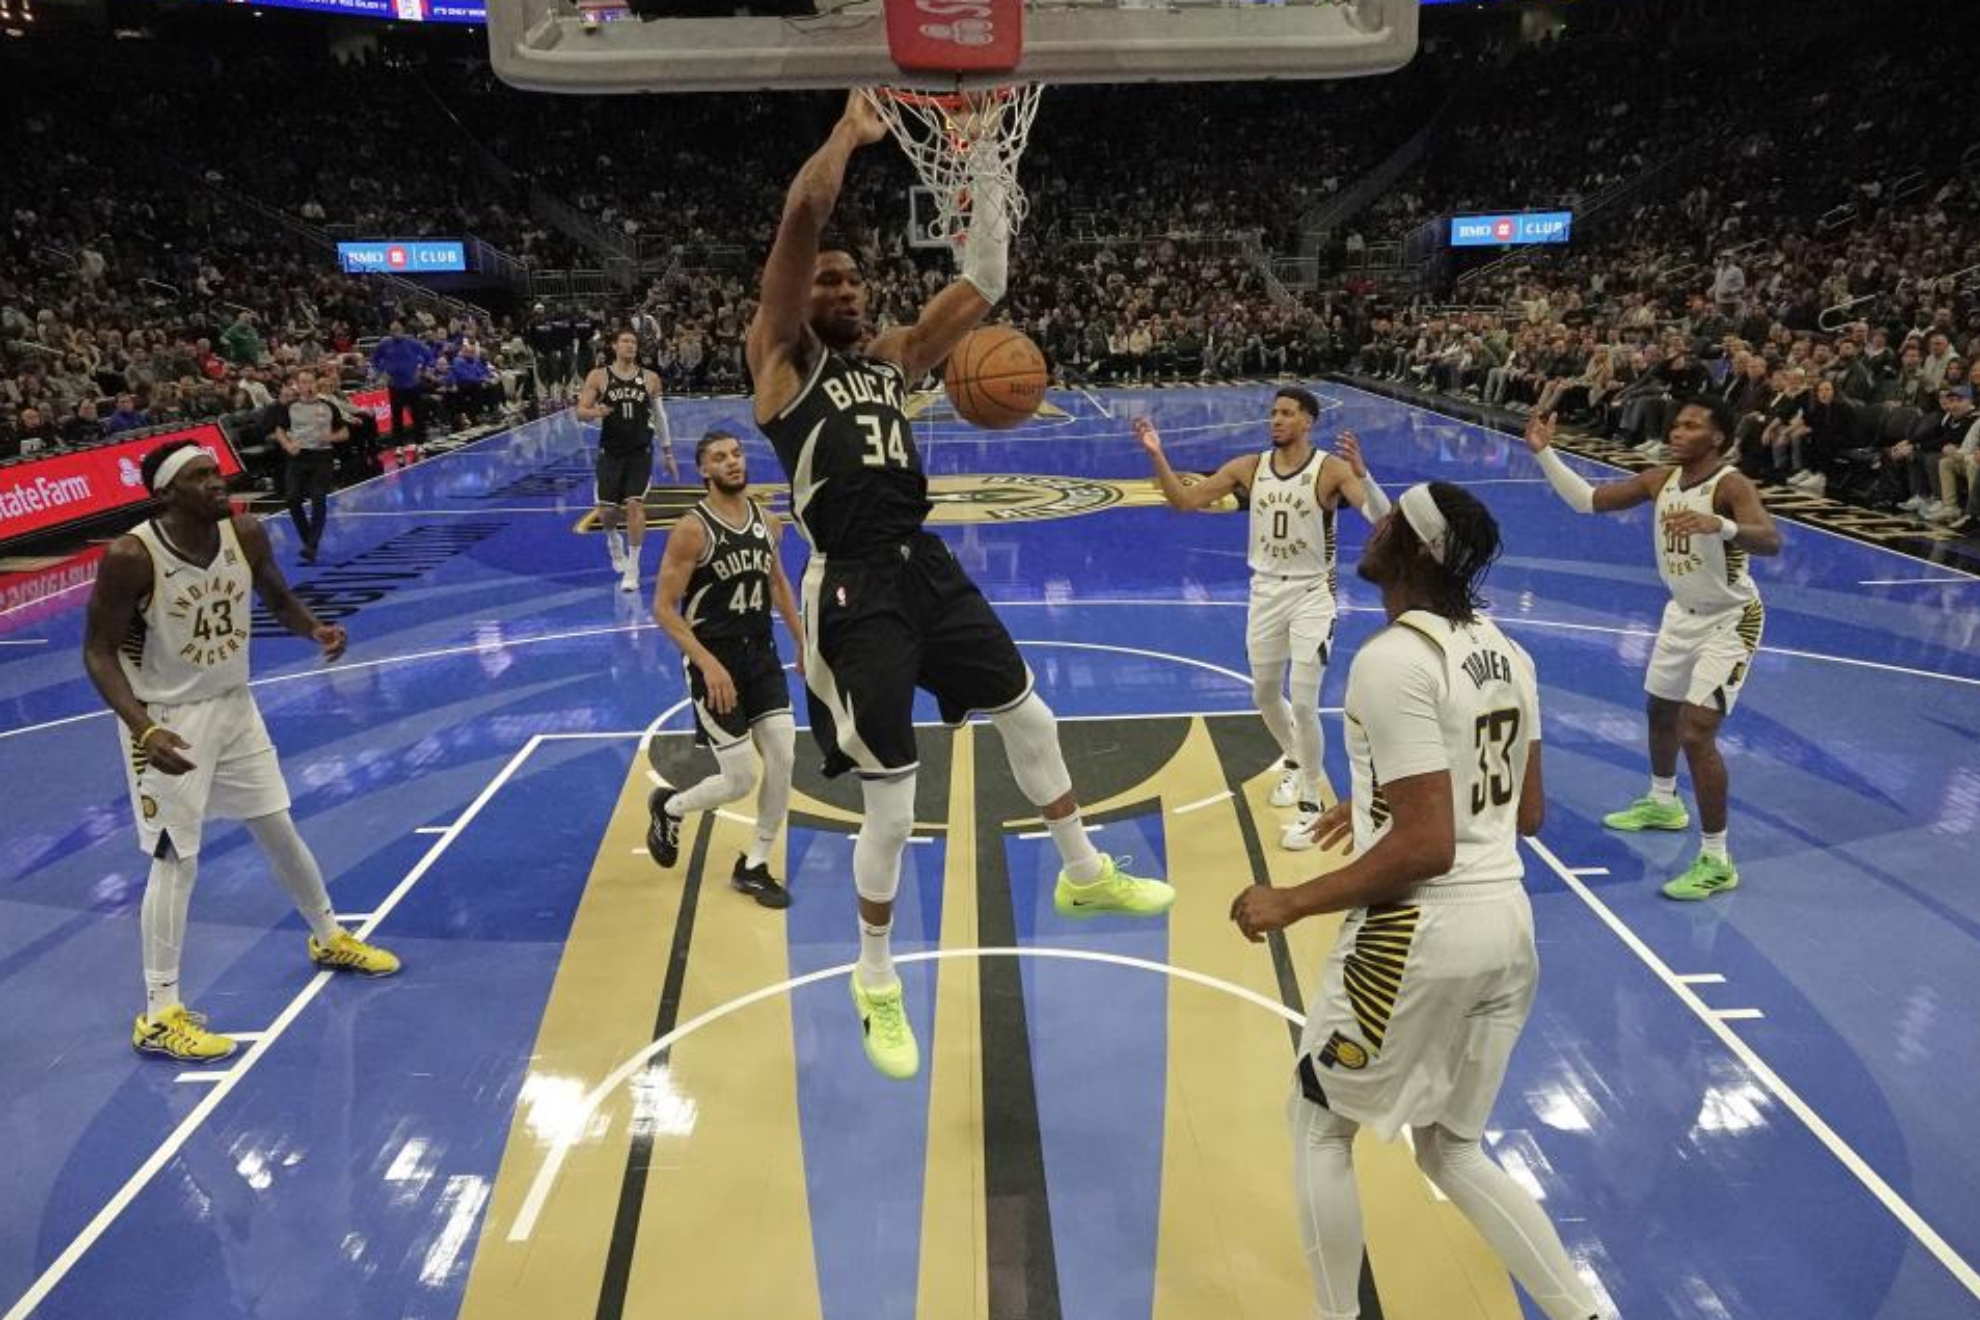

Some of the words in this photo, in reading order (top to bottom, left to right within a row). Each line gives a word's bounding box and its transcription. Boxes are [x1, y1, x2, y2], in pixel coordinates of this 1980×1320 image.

[1459, 224, 1492, 238] BMO
[420, 250, 456, 262] CLUB
[608, 387, 646, 403] BUCKS
[822, 371, 899, 412] BUCK
[622, 402, 633, 419] 11
[855, 414, 908, 468] 34
[0, 476, 92, 519] tateFarm
[1256, 492, 1311, 518] INDIANA
[1274, 510, 1288, 539] 0
[711, 548, 772, 581] BUCKS
[168, 576, 246, 619] INDIANA
[728, 579, 763, 614] 44
[193, 599, 233, 640] 43
[181, 628, 248, 666] PACERS
[1471, 707, 1521, 816] 33
